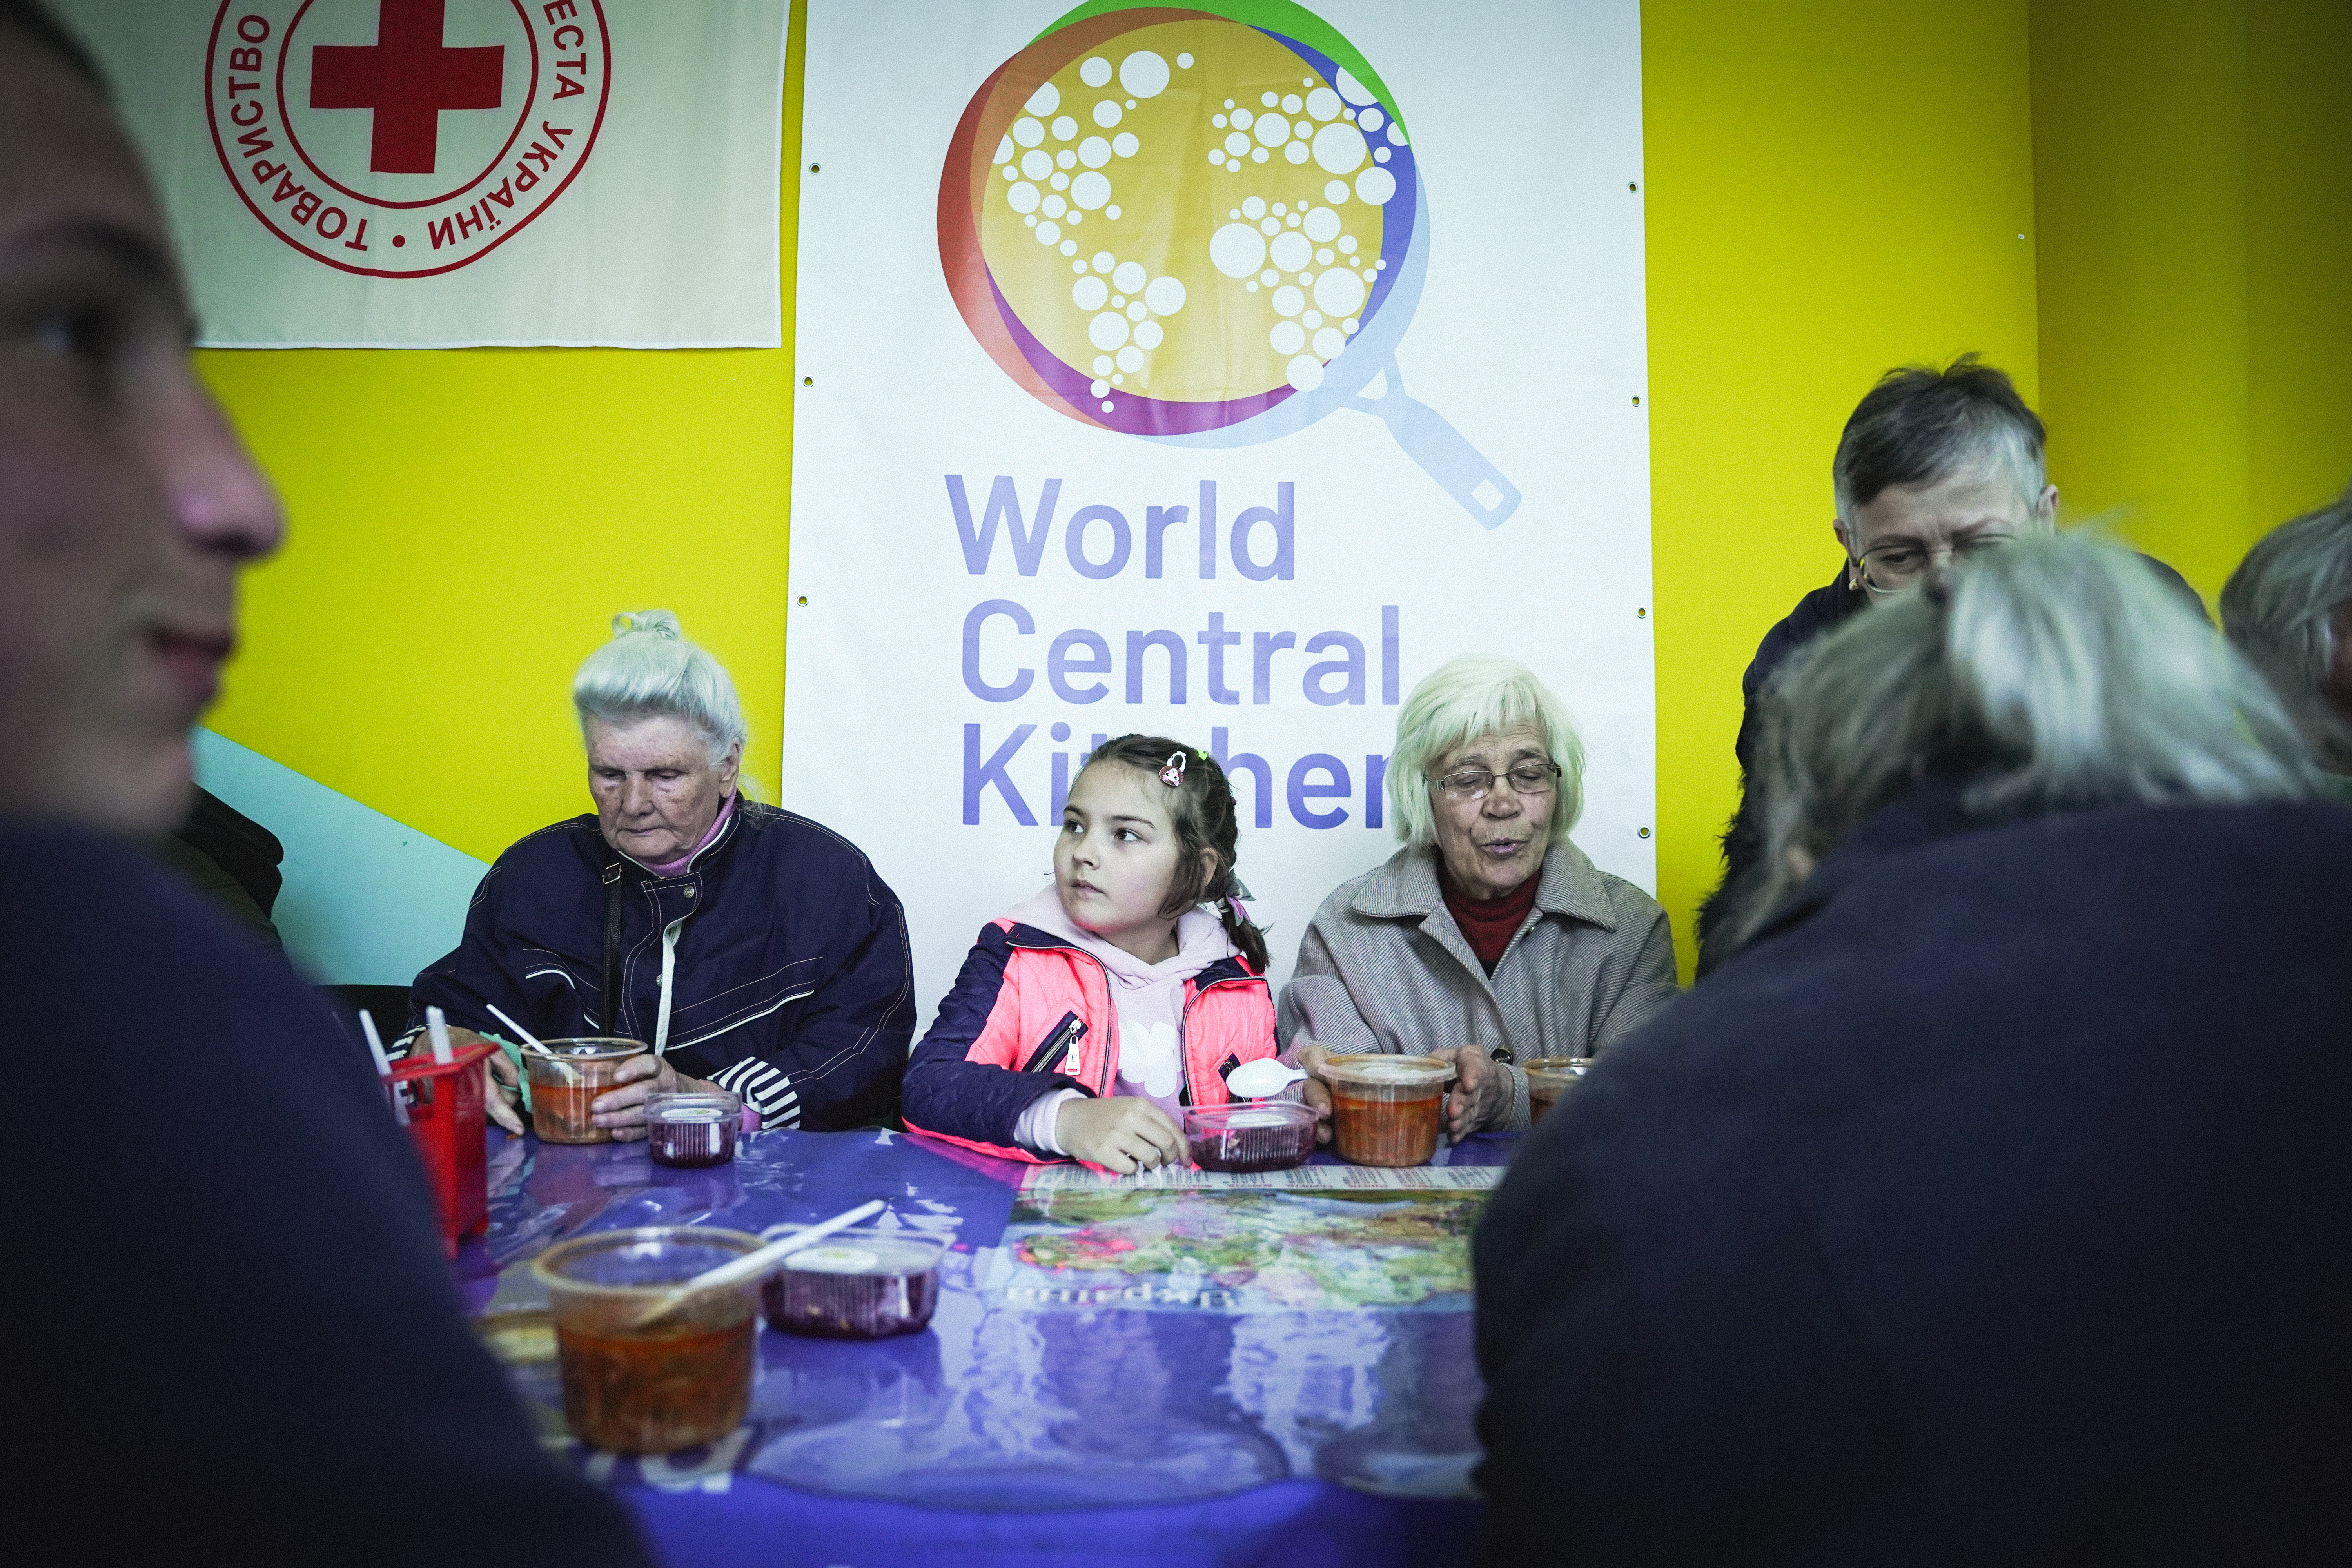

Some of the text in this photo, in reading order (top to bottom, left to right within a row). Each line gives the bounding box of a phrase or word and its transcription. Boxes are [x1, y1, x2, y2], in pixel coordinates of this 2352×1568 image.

[228, 15, 368, 251] ТОВАРИСТВО
[428, 121, 573, 250] УКРАЇНИ
[943, 473, 1295, 581] World
[961, 598, 1400, 706] Central
[962, 721, 1390, 831] Kihe
